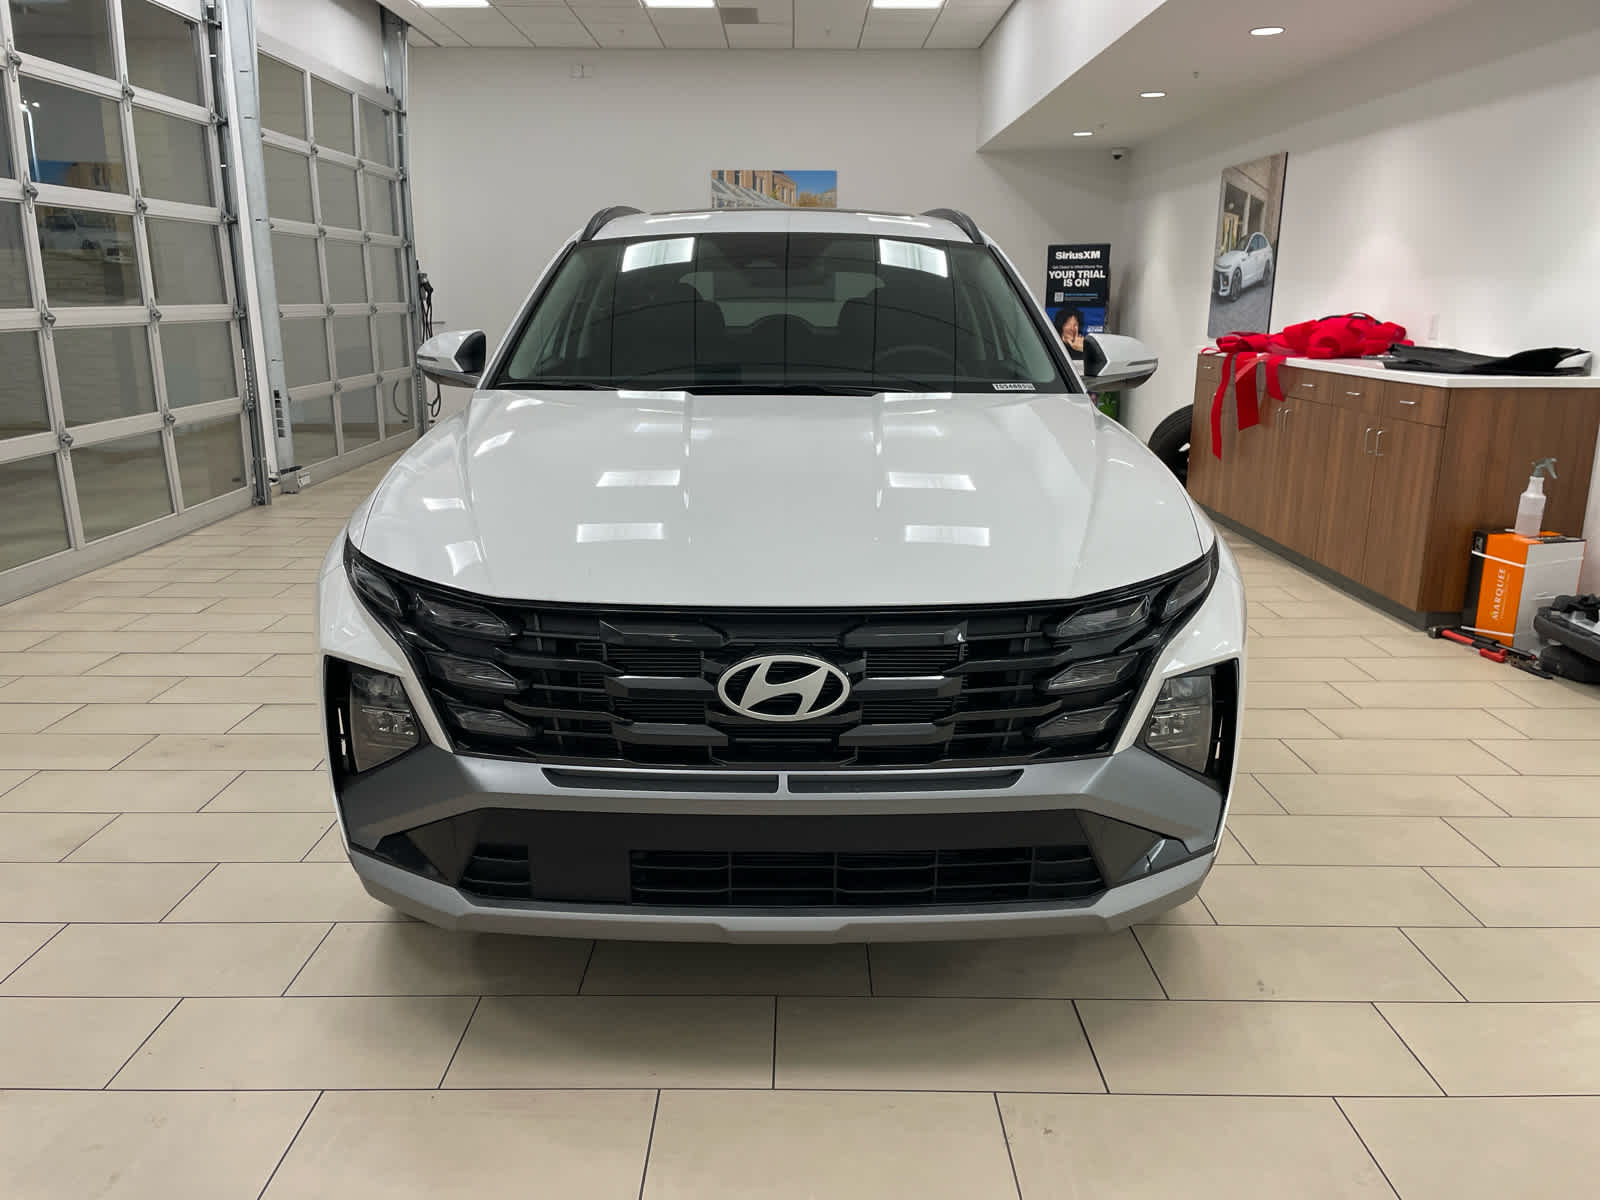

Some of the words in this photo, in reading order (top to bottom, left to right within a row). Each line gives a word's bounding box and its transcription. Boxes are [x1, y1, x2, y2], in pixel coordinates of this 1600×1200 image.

[1055, 250, 1101, 260] SiriusXM
[1049, 270, 1076, 279] YOUR
[1077, 269, 1106, 279] TRIAL
[1063, 278, 1073, 287] IS
[1074, 278, 1090, 287] ON
[1491, 568, 1506, 620] MARQUEE
